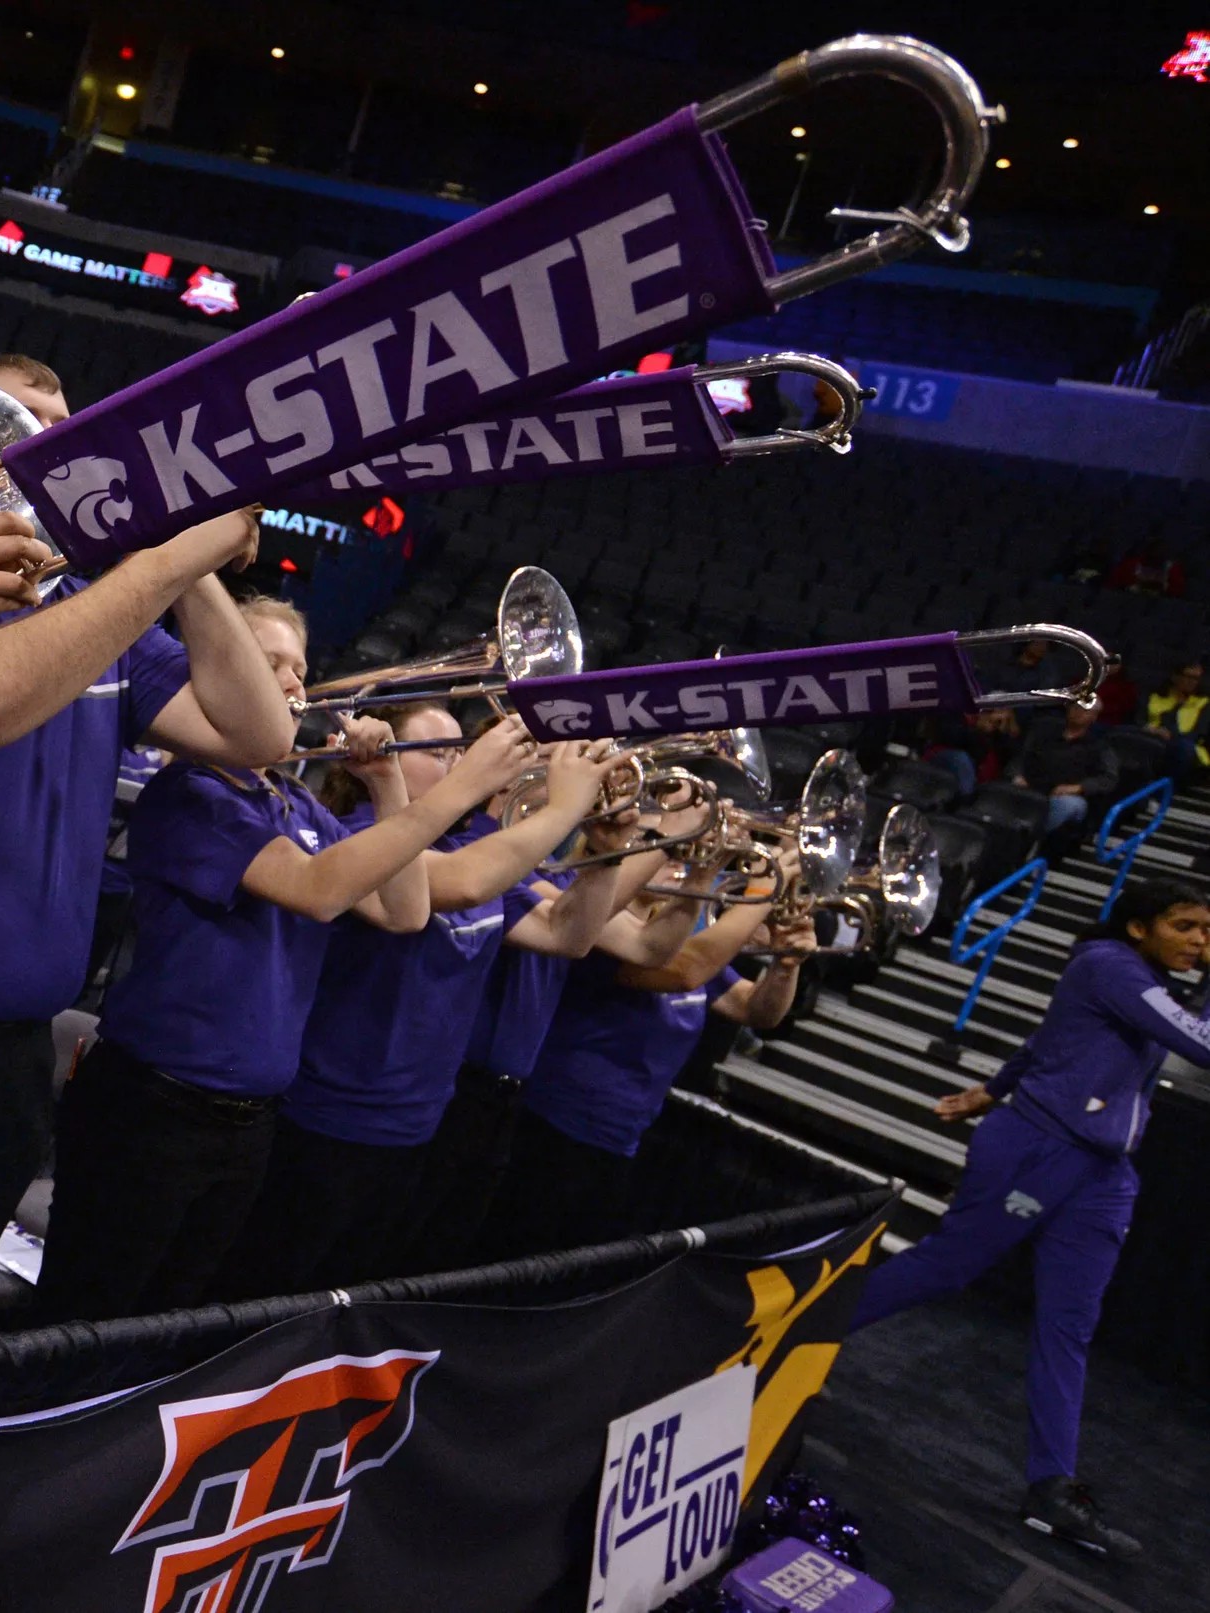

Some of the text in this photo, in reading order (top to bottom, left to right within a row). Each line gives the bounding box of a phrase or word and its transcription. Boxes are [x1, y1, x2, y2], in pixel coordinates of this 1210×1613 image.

[23, 244, 83, 273] GAME
[139, 193, 689, 514] K-STATE
[871, 373, 937, 414] 113
[605, 663, 941, 731] K-STATE
[621, 1412, 682, 1520] GET
[664, 1470, 740, 1585] LOUD
